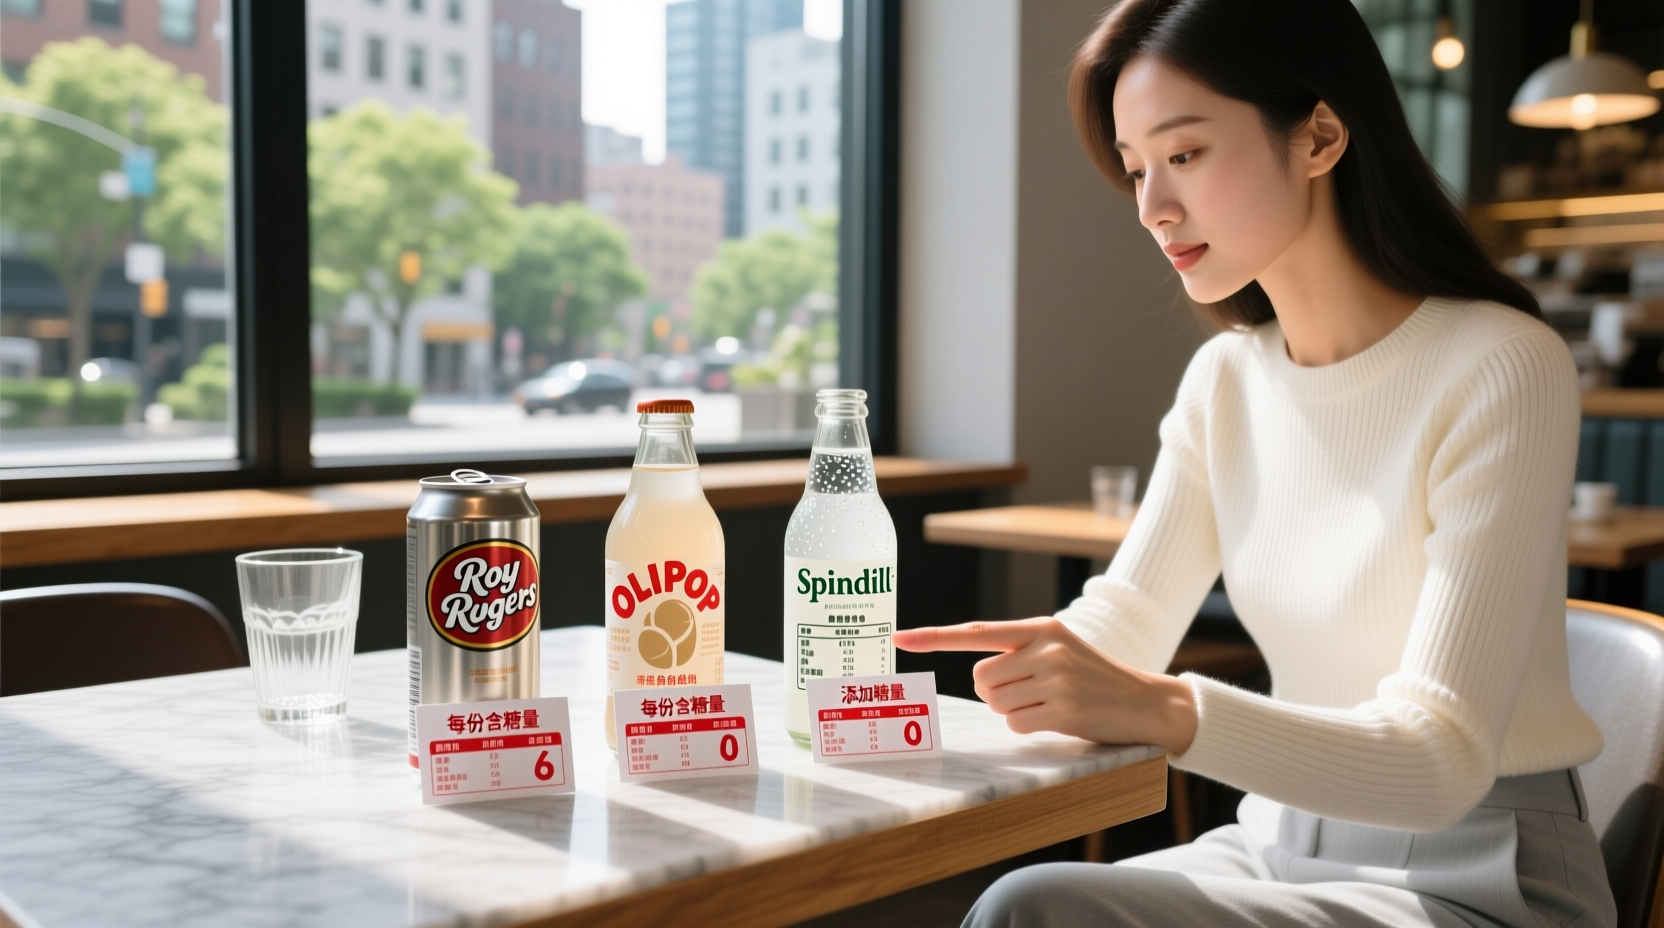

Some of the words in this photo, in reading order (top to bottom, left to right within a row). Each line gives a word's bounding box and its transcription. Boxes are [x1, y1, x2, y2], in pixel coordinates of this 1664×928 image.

[454, 557, 520, 596] Roy
[612, 560, 720, 619] OLIPOP
[797, 566, 892, 603] Spindill
[641, 695, 726, 718] 每份含糖量
[447, 709, 540, 734] 每份含糖量
[904, 720, 922, 746] 0
[720, 734, 739, 761] 0
[534, 750, 555, 781] 6
